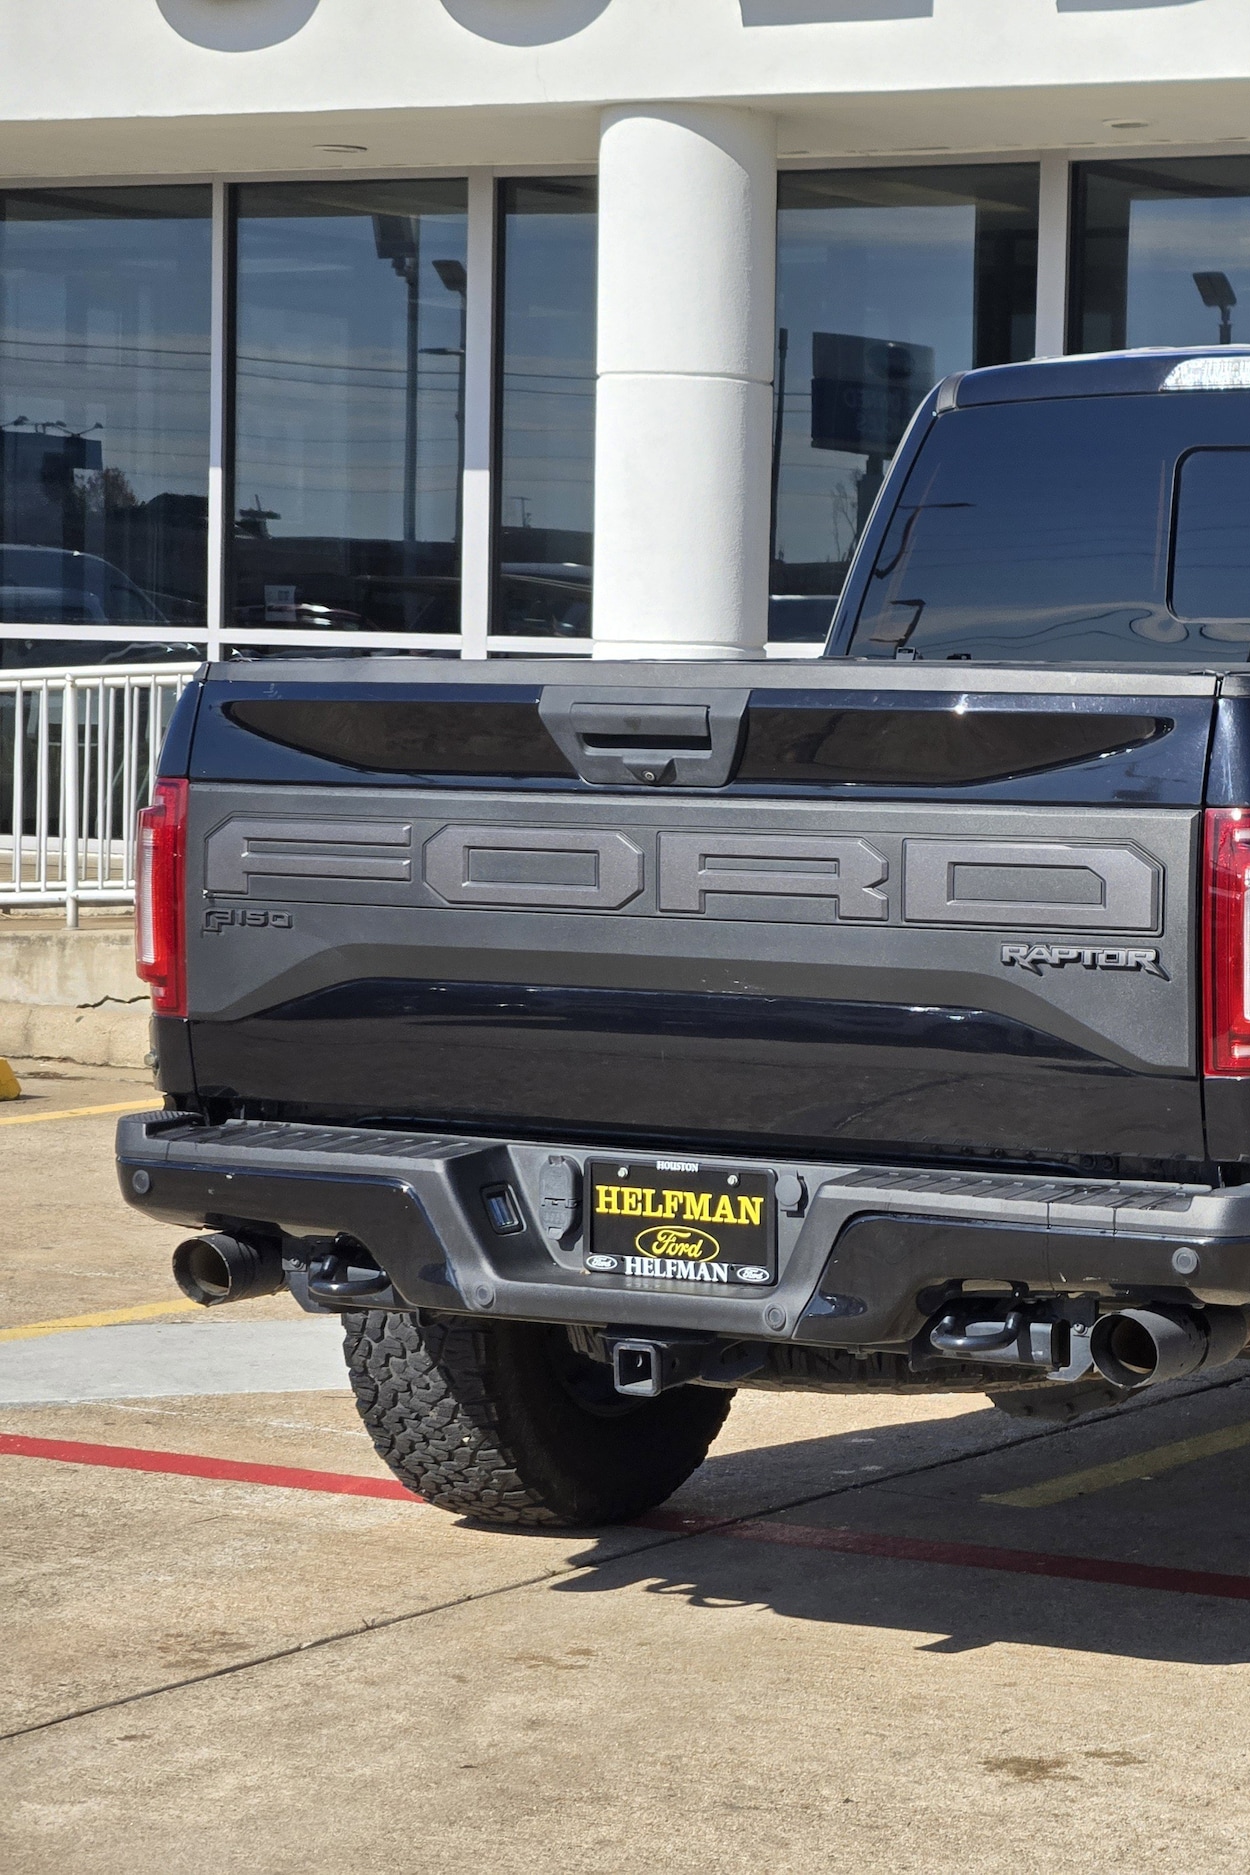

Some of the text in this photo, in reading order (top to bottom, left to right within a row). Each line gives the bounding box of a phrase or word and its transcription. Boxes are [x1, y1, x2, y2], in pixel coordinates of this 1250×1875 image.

[205, 812, 1163, 934] FORD
[1001, 943, 1170, 981] RAPTOR
[656, 1160, 699, 1172] HOUSTON
[595, 1185, 764, 1226] HELFMAN
[652, 1229, 704, 1258] Ford
[624, 1256, 729, 1283] HELFMAN
